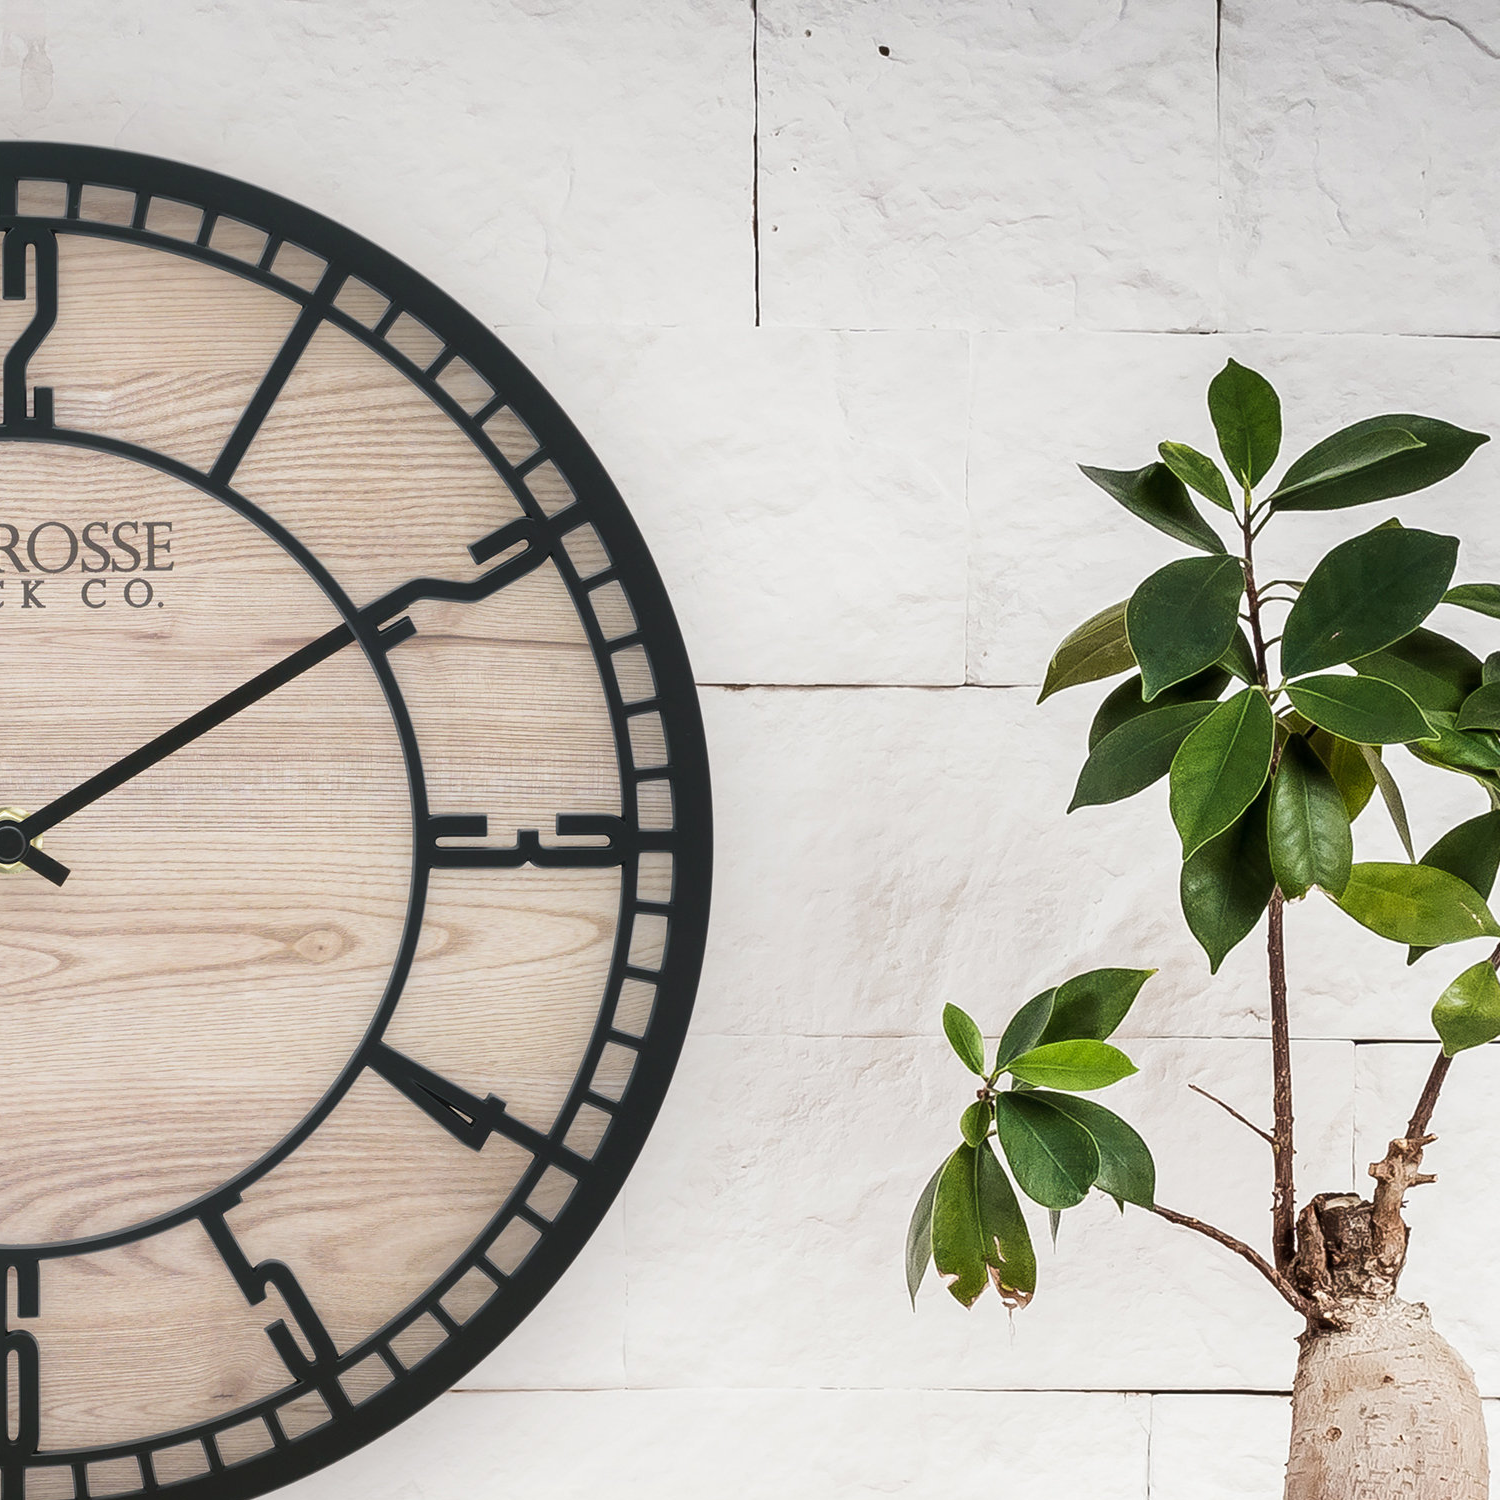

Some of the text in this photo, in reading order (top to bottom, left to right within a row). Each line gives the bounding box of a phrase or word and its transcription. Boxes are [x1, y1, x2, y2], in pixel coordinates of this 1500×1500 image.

[208, 300, 326, 490] 1
[81, 577, 164, 609] CO.
[356, 515, 554, 655] 2
[425, 812, 626, 868] 3
[364, 1040, 550, 1155] 4
[196, 1196, 342, 1386] 5
